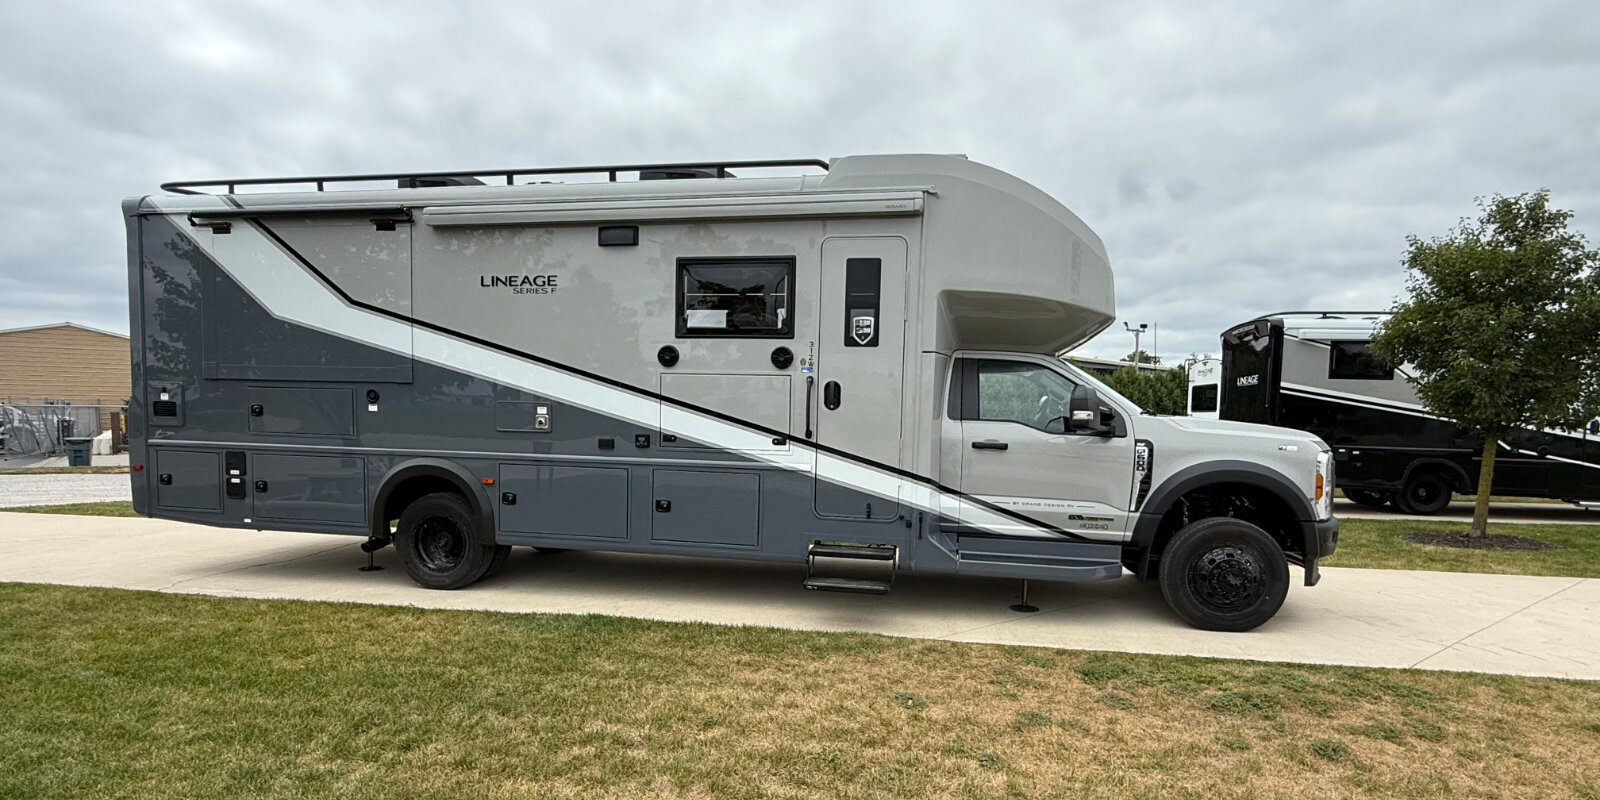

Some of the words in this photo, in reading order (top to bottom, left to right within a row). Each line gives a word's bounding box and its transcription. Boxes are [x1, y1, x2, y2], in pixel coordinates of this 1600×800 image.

[480, 275, 558, 287] LINEAGE
[512, 287, 548, 295] SERIES
[550, 287, 557, 295] F
[1237, 374, 1259, 386] LINEAGE
